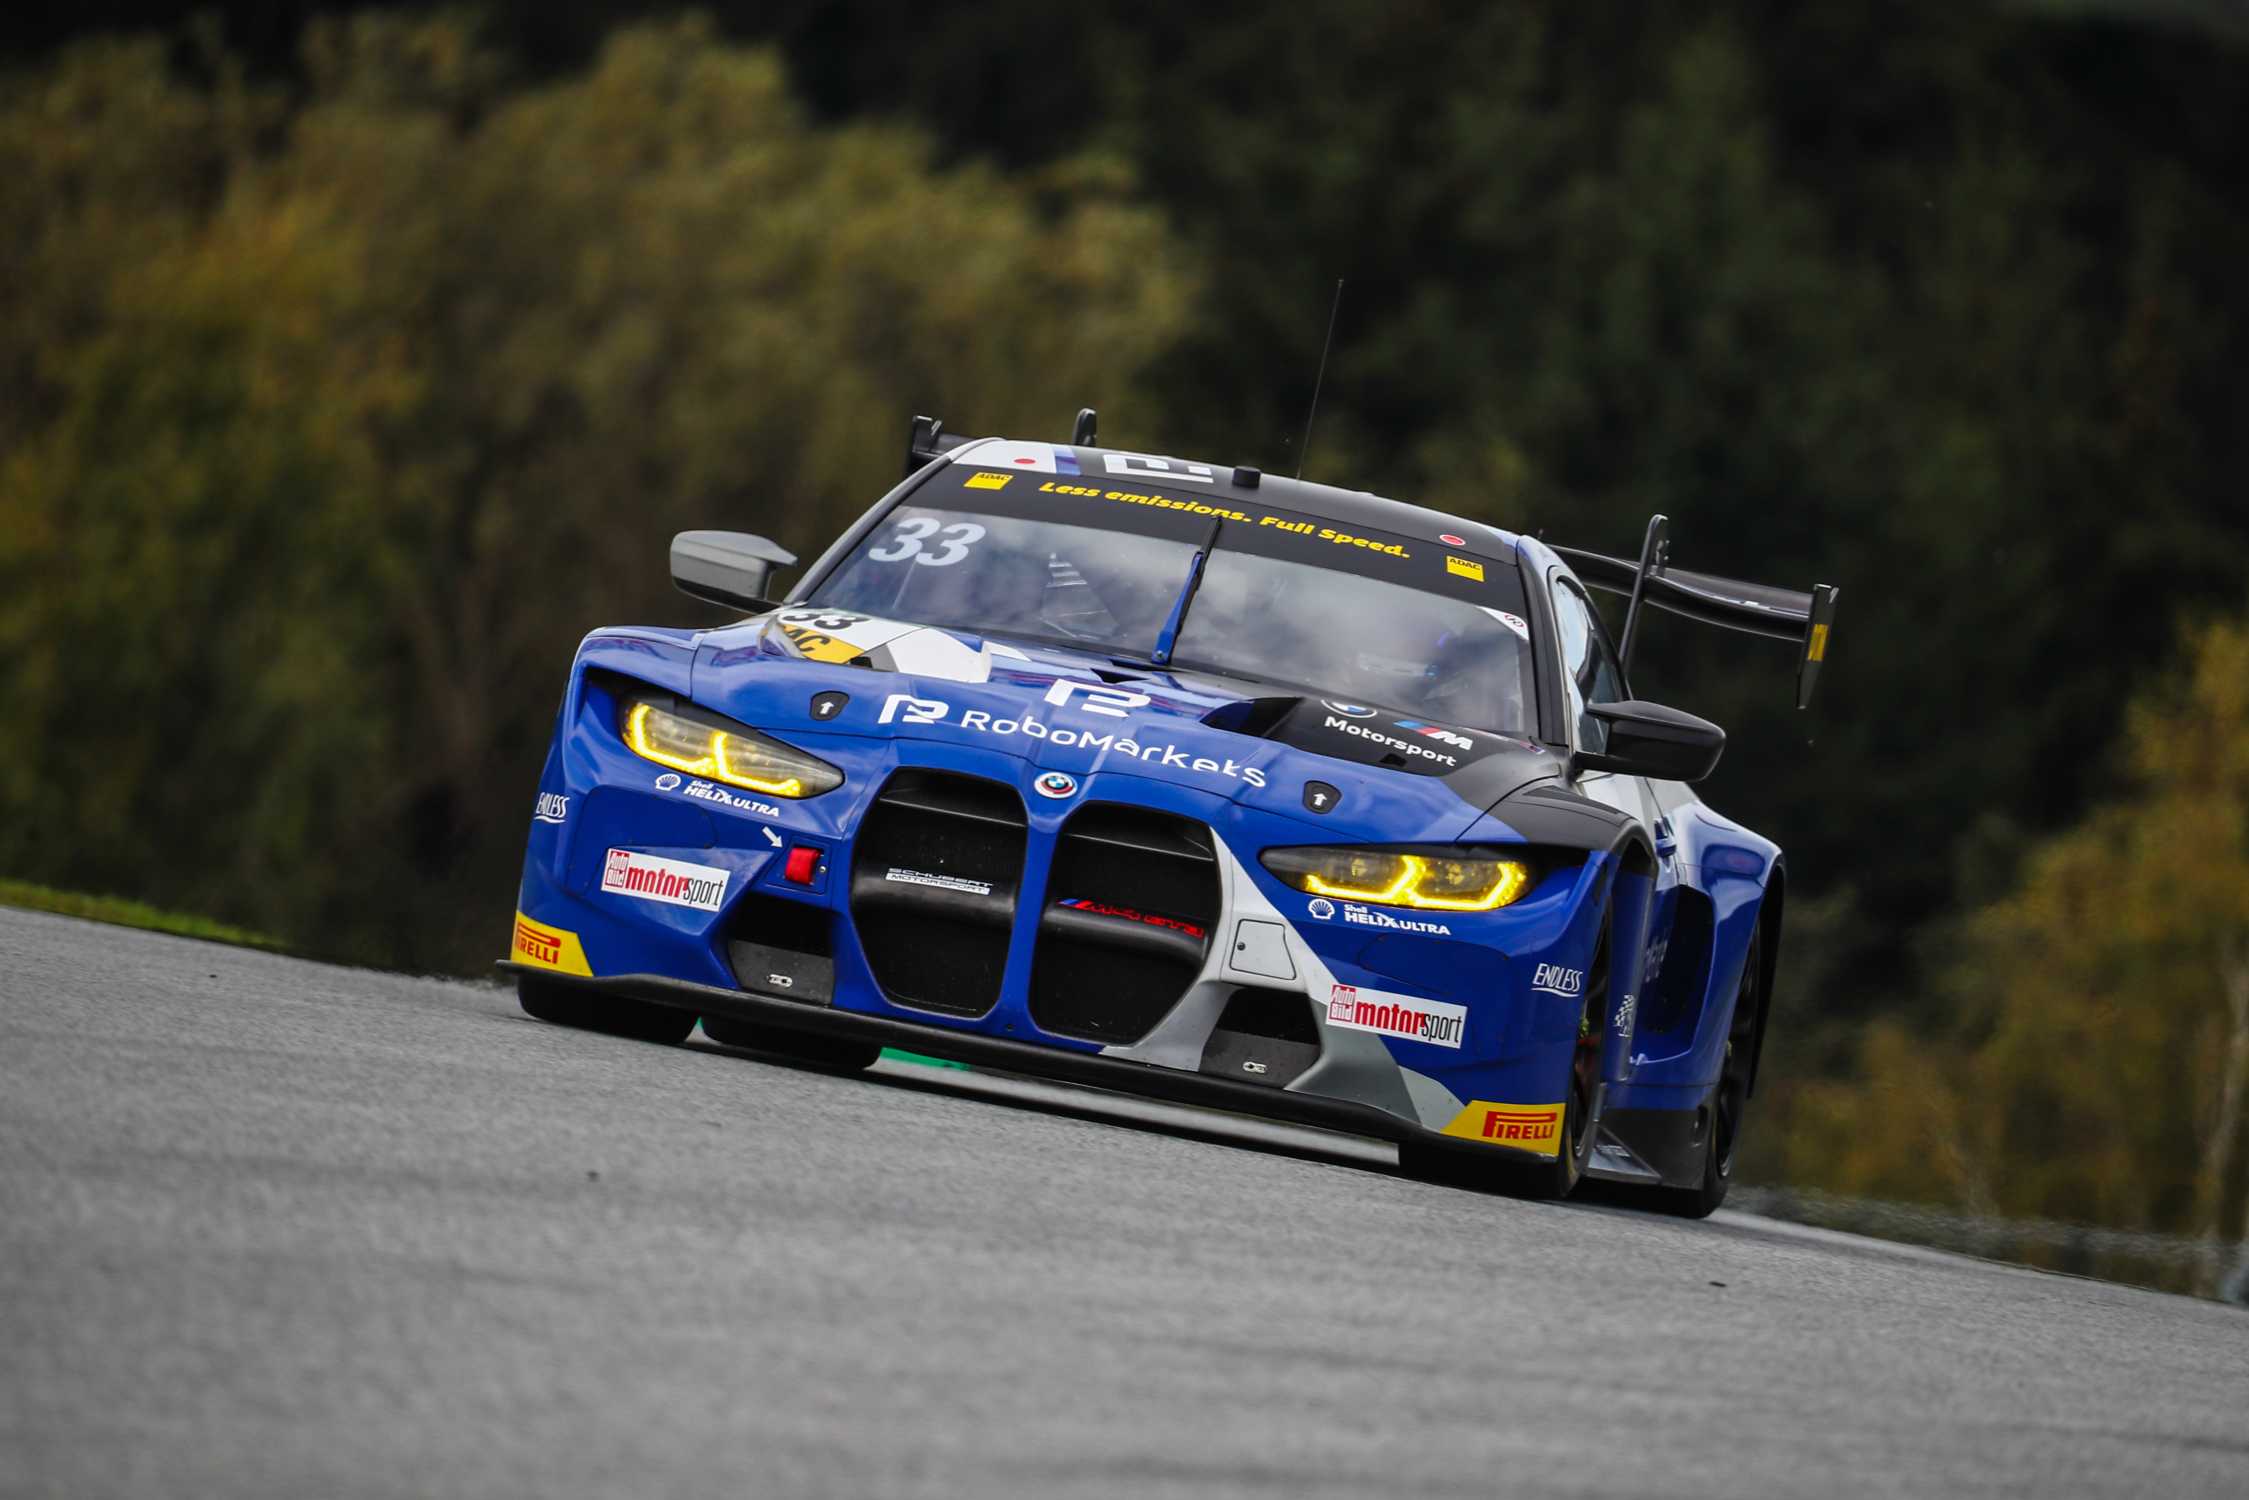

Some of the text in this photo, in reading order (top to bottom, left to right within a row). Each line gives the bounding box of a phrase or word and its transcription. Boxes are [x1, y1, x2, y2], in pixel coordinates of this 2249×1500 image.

[1039, 482, 1411, 559] Less emissions. Full Speed.
[868, 517, 986, 566] 33
[1449, 558, 1481, 571] ADAC
[960, 710, 1267, 788] RoboMarkets
[1325, 716, 1457, 767] Motorsport
[684, 785, 779, 816] HELIX ULTRA
[1344, 904, 1368, 914] Shell
[1344, 911, 1451, 935] HELIX ULTRA
[1532, 963, 1583, 992] ENDLESS
[1483, 1111, 1557, 1139] PIRELLI
